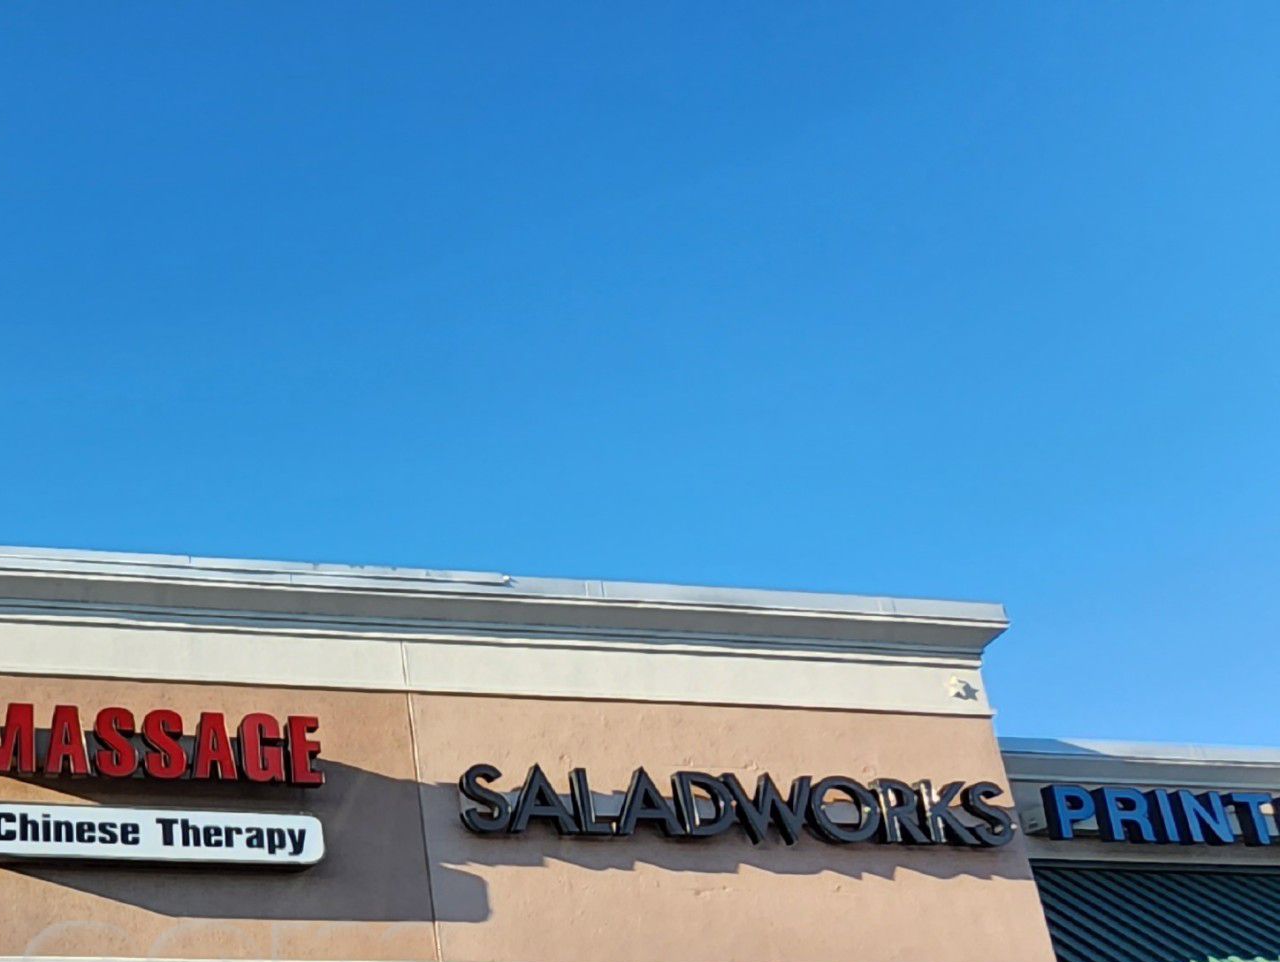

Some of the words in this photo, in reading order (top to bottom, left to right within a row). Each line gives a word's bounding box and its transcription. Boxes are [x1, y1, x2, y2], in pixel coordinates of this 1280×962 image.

[458, 762, 1016, 848] SALADWORKS
[1041, 784, 1280, 846] PRINT
[156, 817, 307, 857] Therapy
